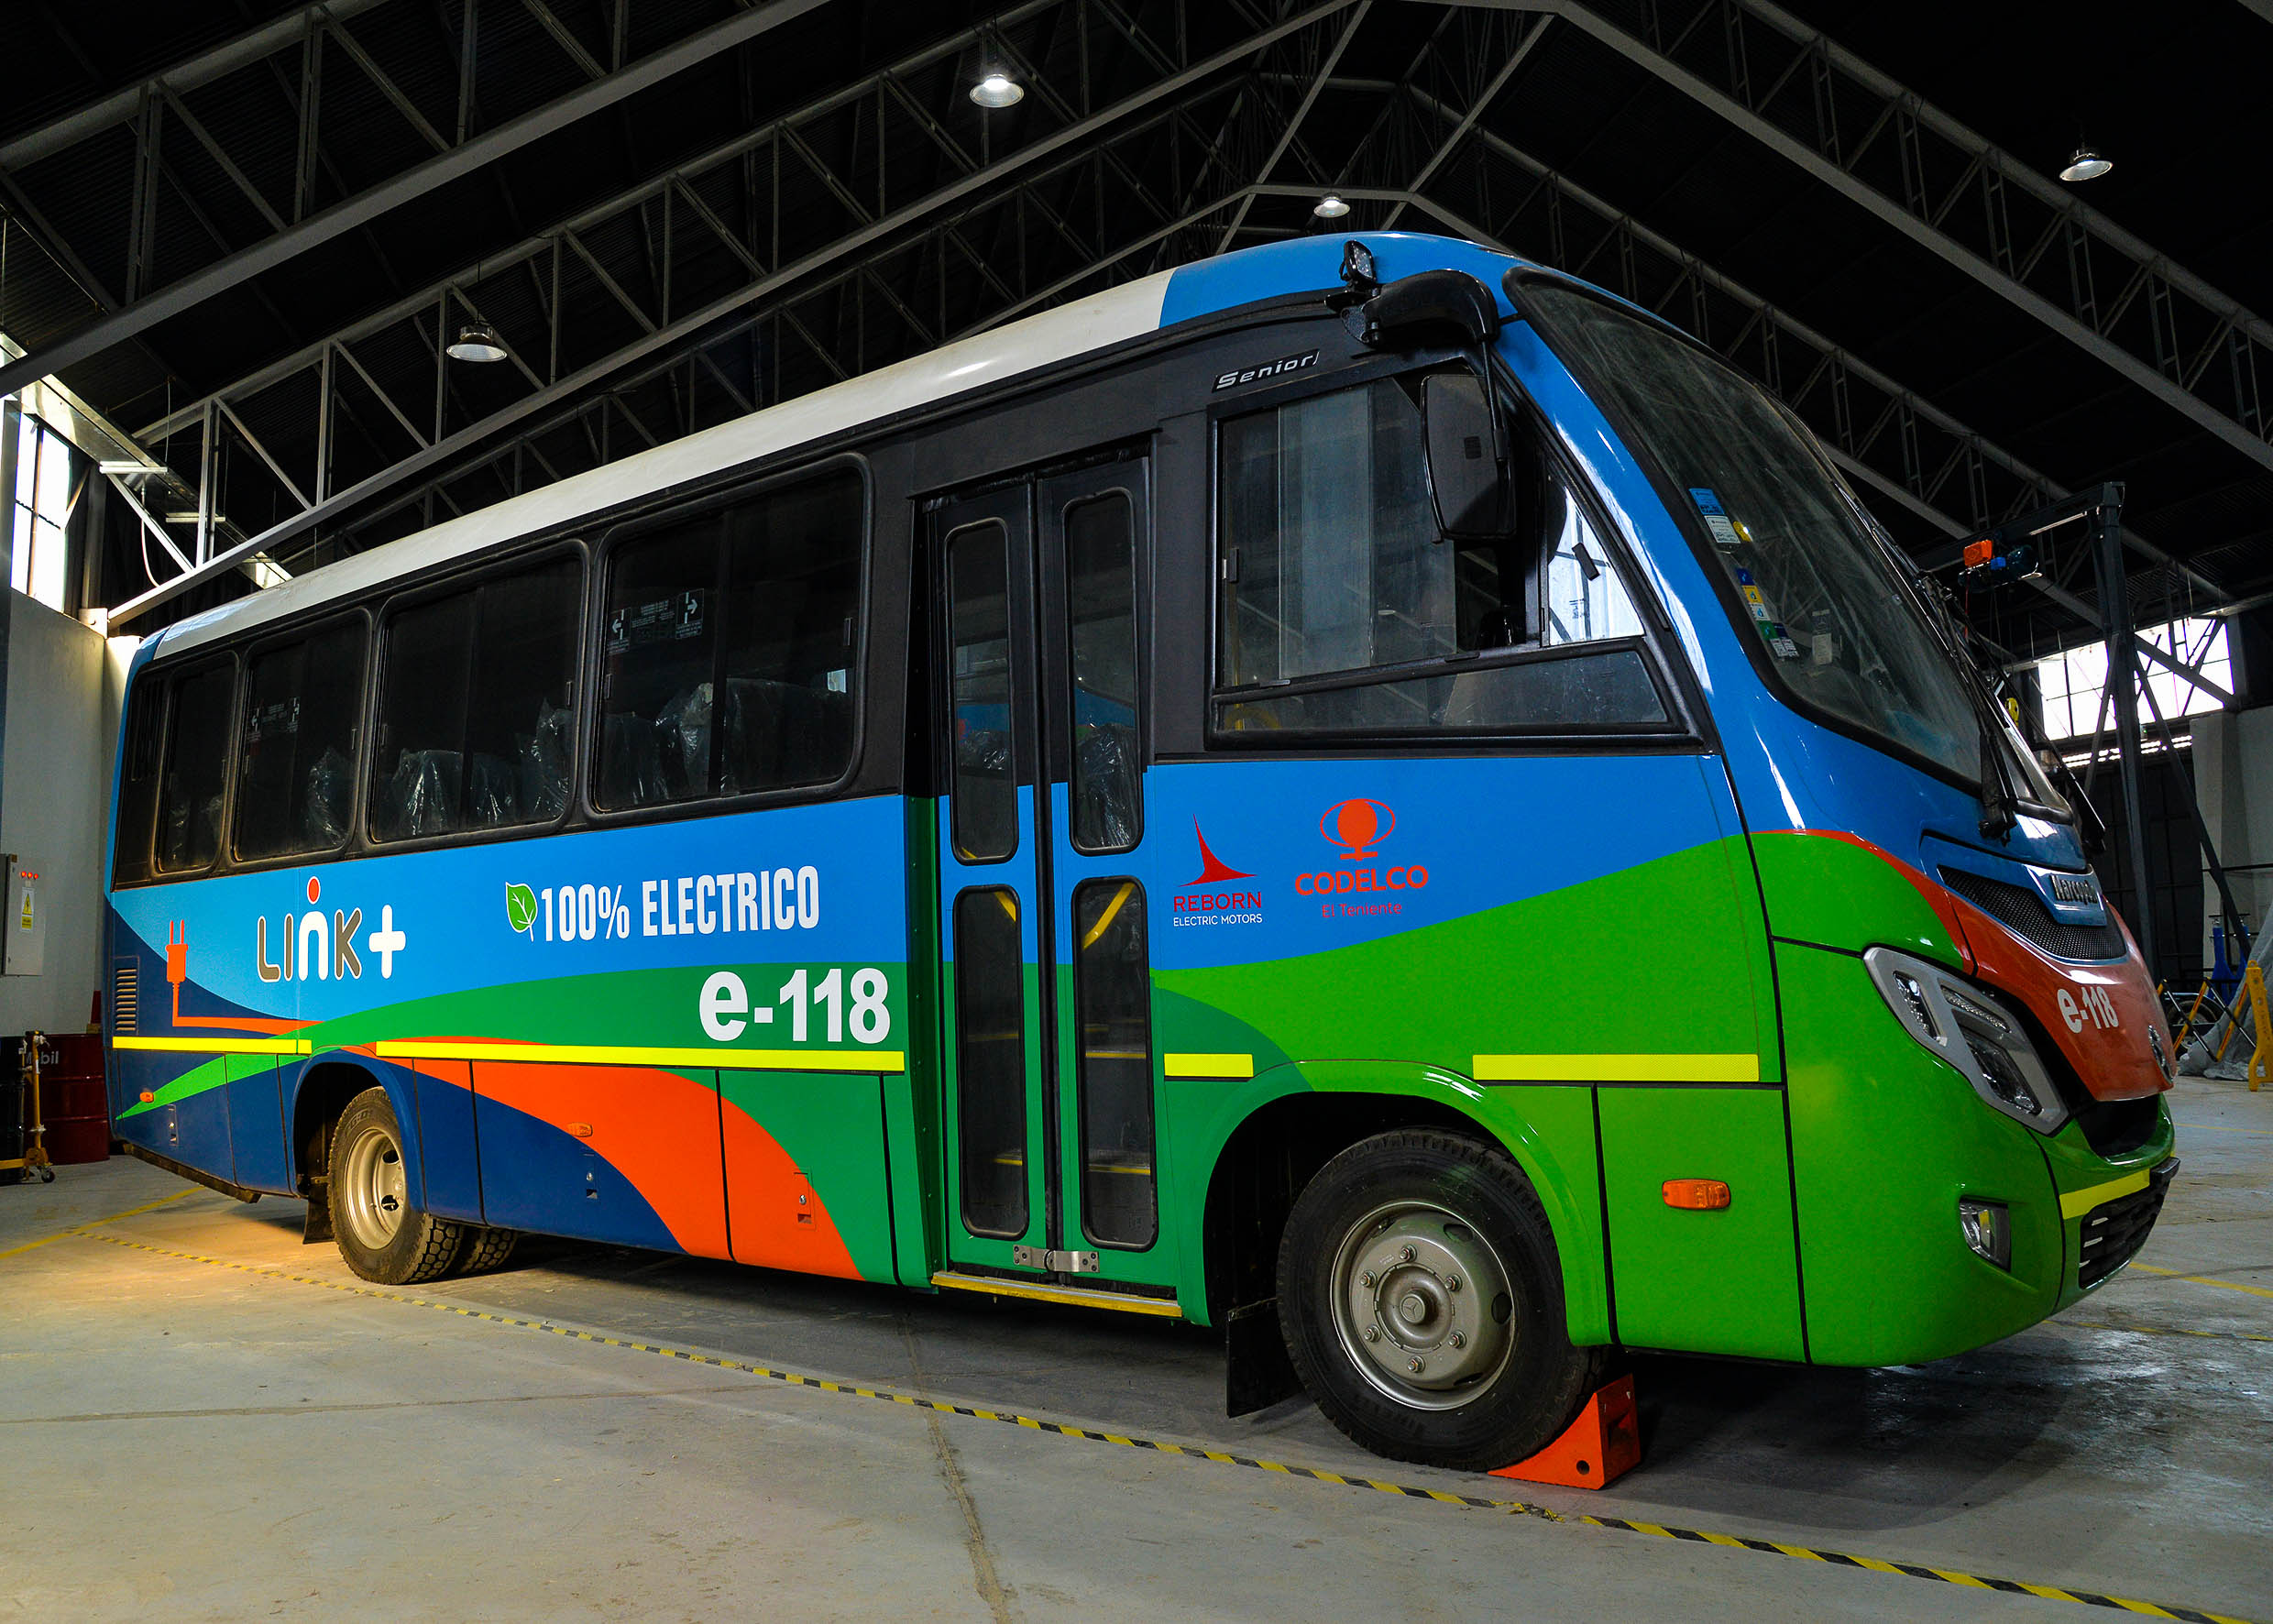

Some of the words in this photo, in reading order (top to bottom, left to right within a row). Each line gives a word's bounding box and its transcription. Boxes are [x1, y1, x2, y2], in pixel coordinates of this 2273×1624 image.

[1216, 354, 1313, 390] Senior
[1294, 864, 1429, 896] CODELCO
[540, 883, 631, 942] 100%
[642, 865, 820, 937] ELECTRICO
[1173, 891, 1262, 913] REBORN
[1322, 903, 1335, 918] El
[1339, 902, 1403, 917] Teniente
[1173, 915, 1219, 927] ELECTRIC
[1221, 913, 1263, 925] MOTORS
[698, 967, 891, 1044] e-118
[2057, 986, 2119, 1034] e-118
[27, 1050, 60, 1064] Mbil
